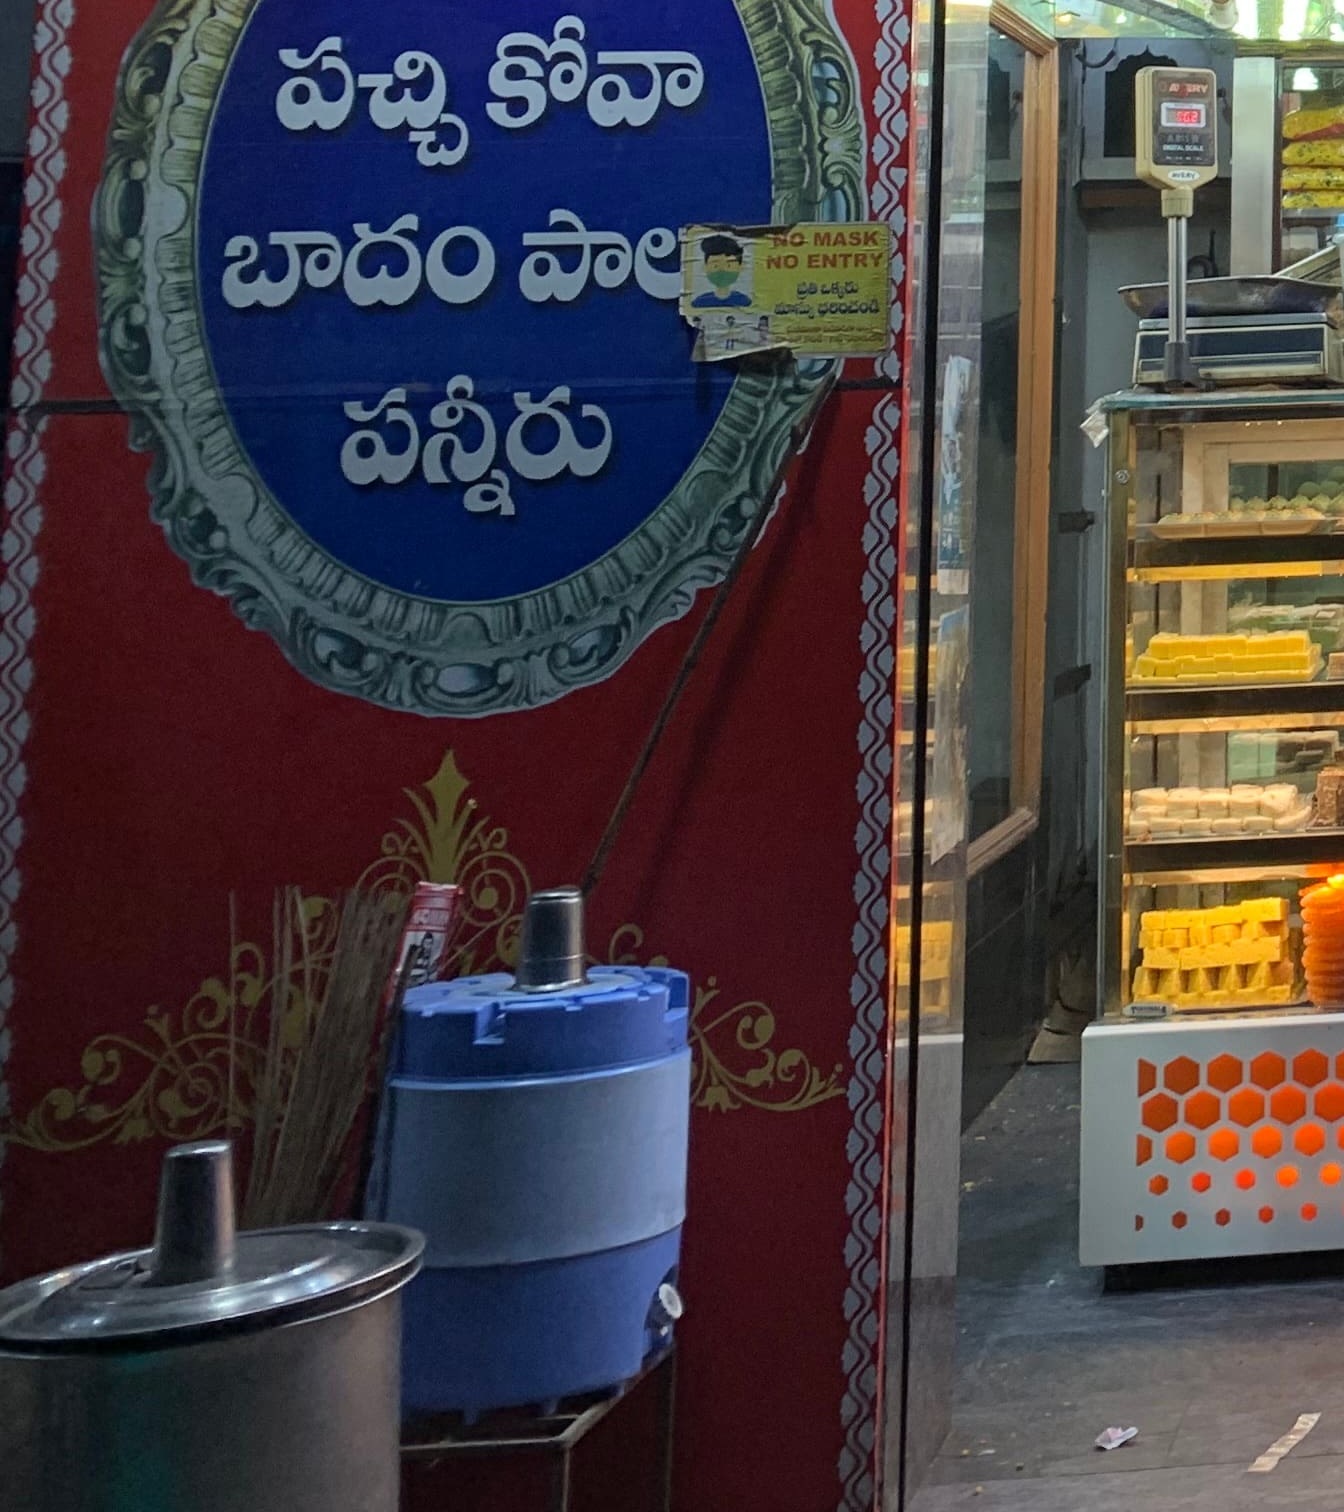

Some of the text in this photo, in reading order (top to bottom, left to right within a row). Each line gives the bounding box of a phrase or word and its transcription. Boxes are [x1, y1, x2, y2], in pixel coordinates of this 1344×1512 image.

[276, 15, 704, 167] పచ్చి కోవా
[221, 213, 496, 308] బాదం
[766, 252, 884, 270] NO ENTRY
[813, 230, 879, 248] MASK
[341, 374, 612, 515] పన్నీరు
